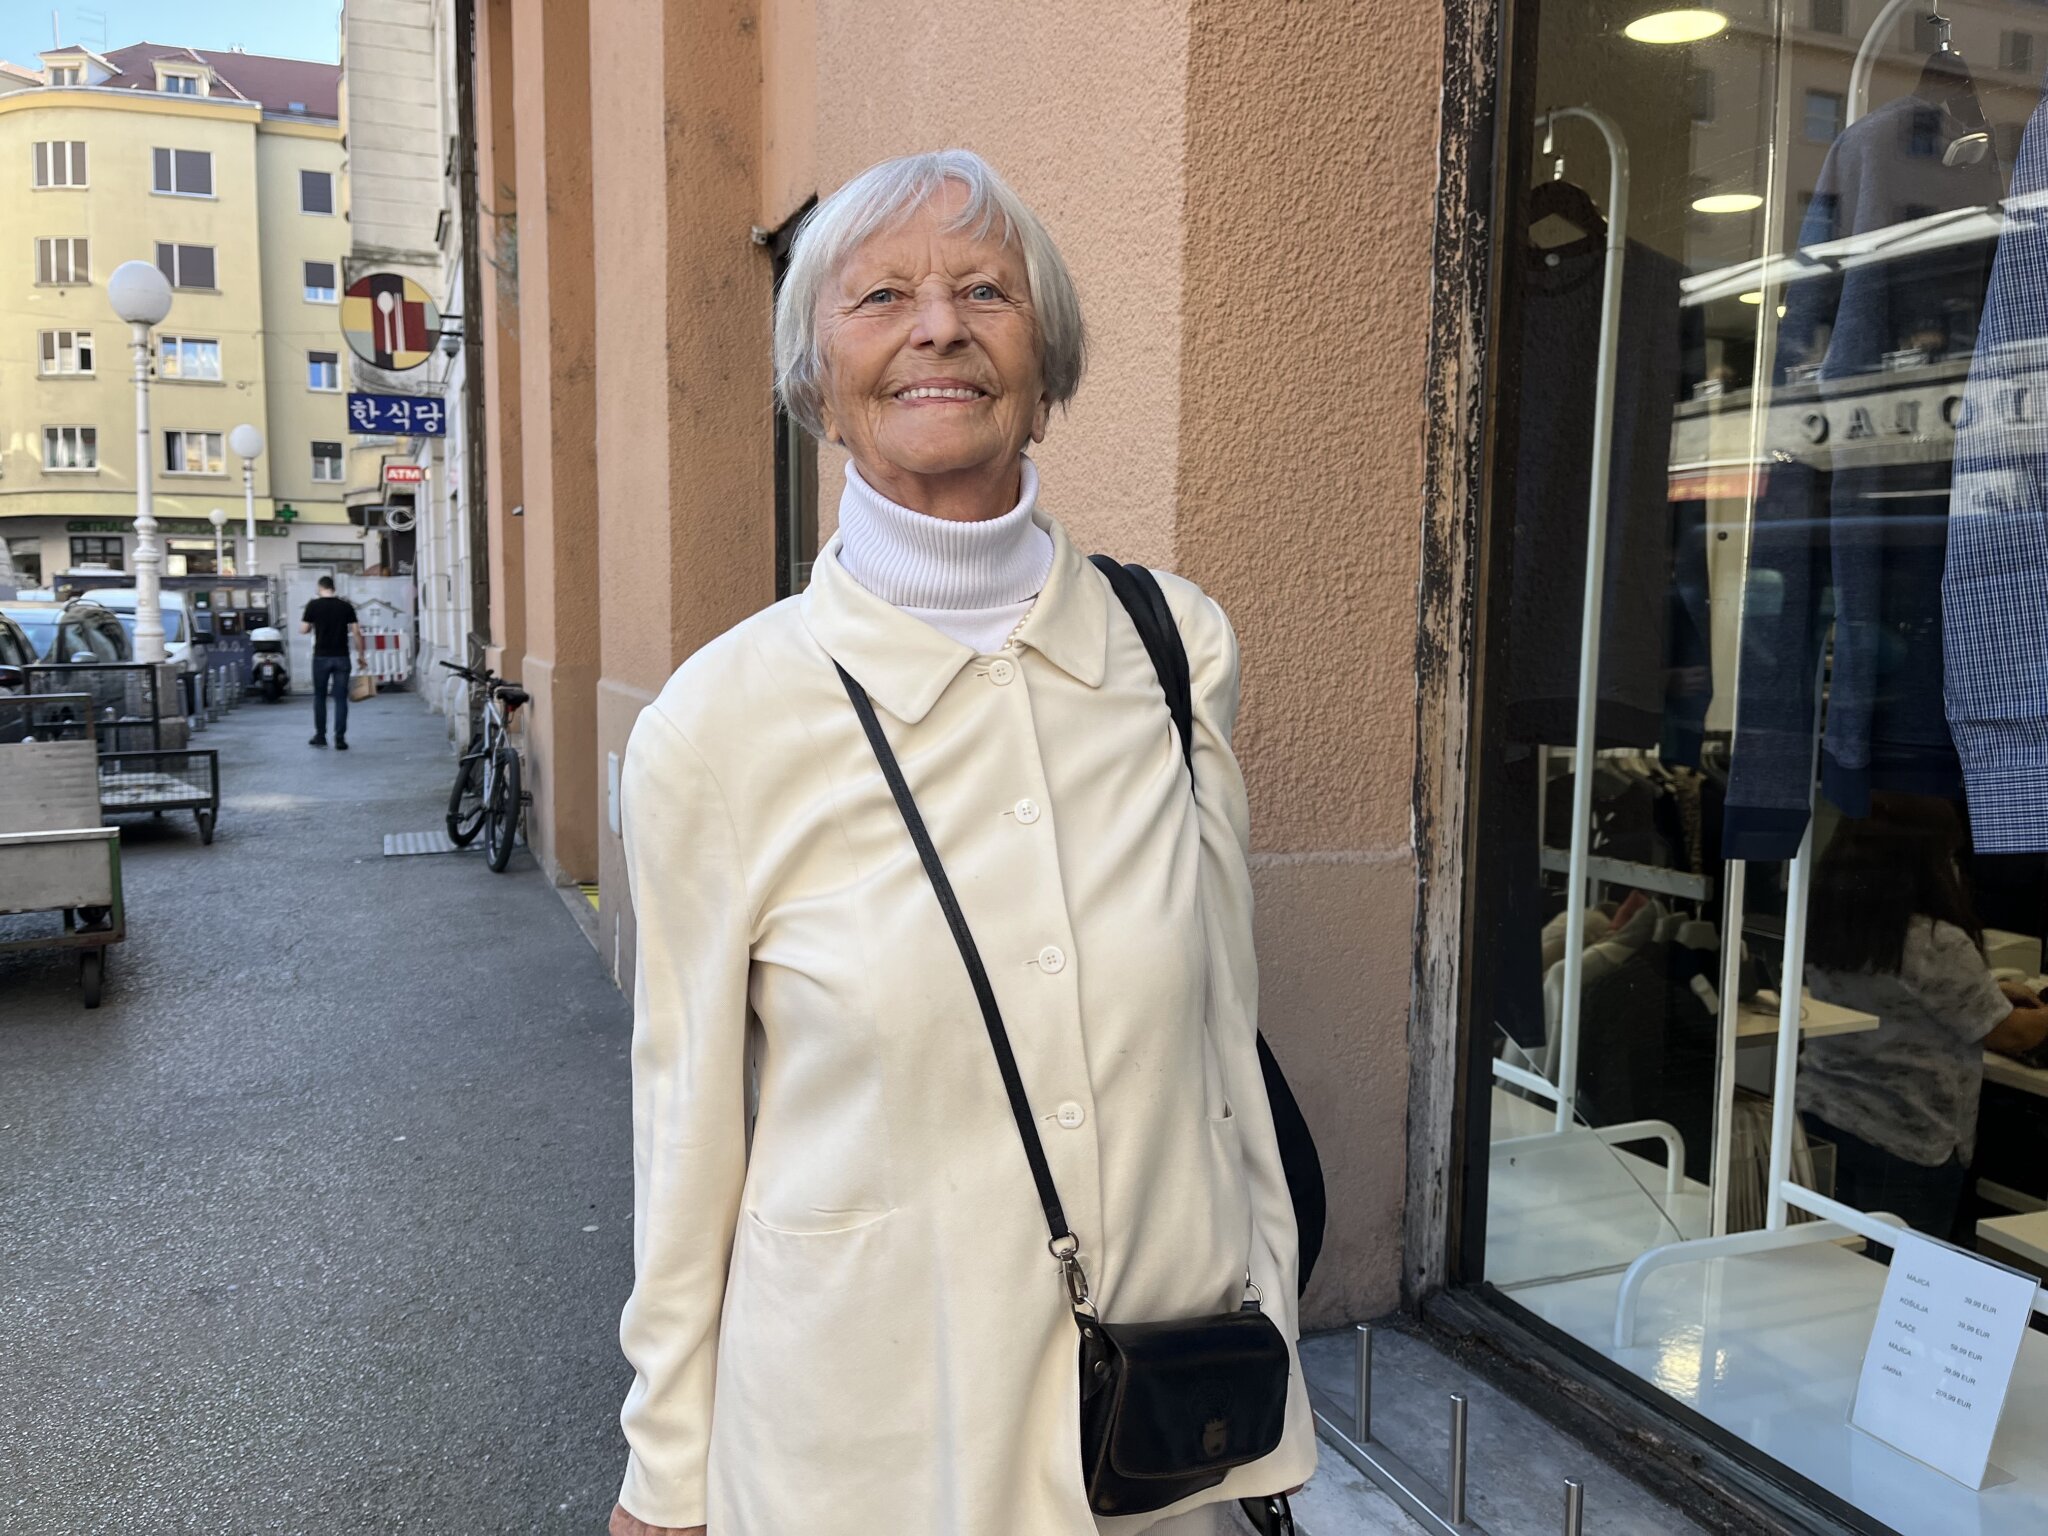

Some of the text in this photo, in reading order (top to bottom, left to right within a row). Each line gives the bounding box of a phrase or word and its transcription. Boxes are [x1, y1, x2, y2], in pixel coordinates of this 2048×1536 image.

[350, 398, 443, 432] 한식당
[387, 468, 420, 480] ATM
[1906, 1273, 1930, 1288] MAJICA
[1982, 1304, 1997, 1315] EUR
[1975, 1328, 1990, 1339] EUR
[1888, 1341, 1912, 1357] MAJICA
[1961, 1374, 1976, 1385] EUR
[1967, 1351, 1983, 1362] EUR
[1956, 1397, 1972, 1410] EUR
